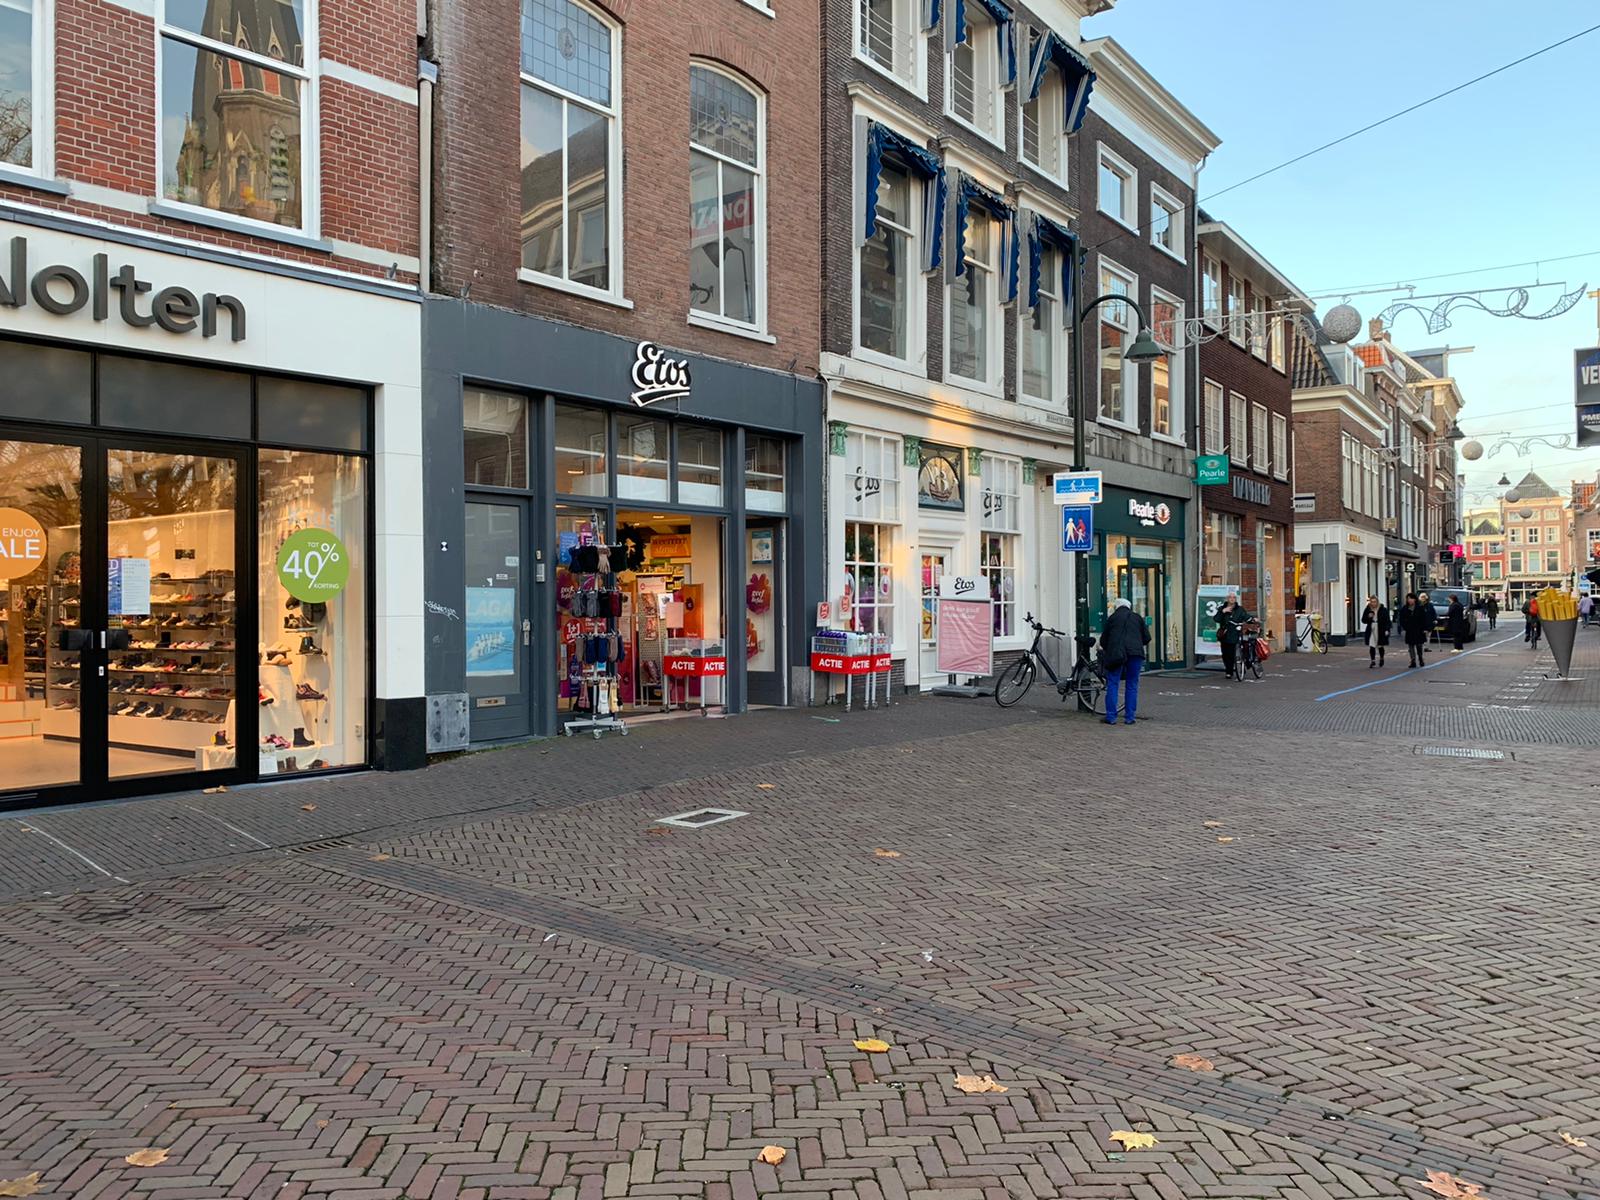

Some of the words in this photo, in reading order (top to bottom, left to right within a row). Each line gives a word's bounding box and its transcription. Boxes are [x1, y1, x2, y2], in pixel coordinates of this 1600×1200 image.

[693, 199, 750, 230] ZANO
[631, 341, 692, 394] Etos
[1581, 365, 1600, 385] VE
[854, 466, 880, 493] Eos
[1129, 499, 1155, 518] Pearle
[2, 528, 40, 538] ENJOY
[954, 577, 975, 593] Etos
[671, 661, 695, 670] ACTIE
[704, 661, 725, 671] ACTIE
[819, 658, 843, 668] ACTIE
[851, 660, 870, 670] ACTIE
[876, 658, 891, 667] ACTIE
